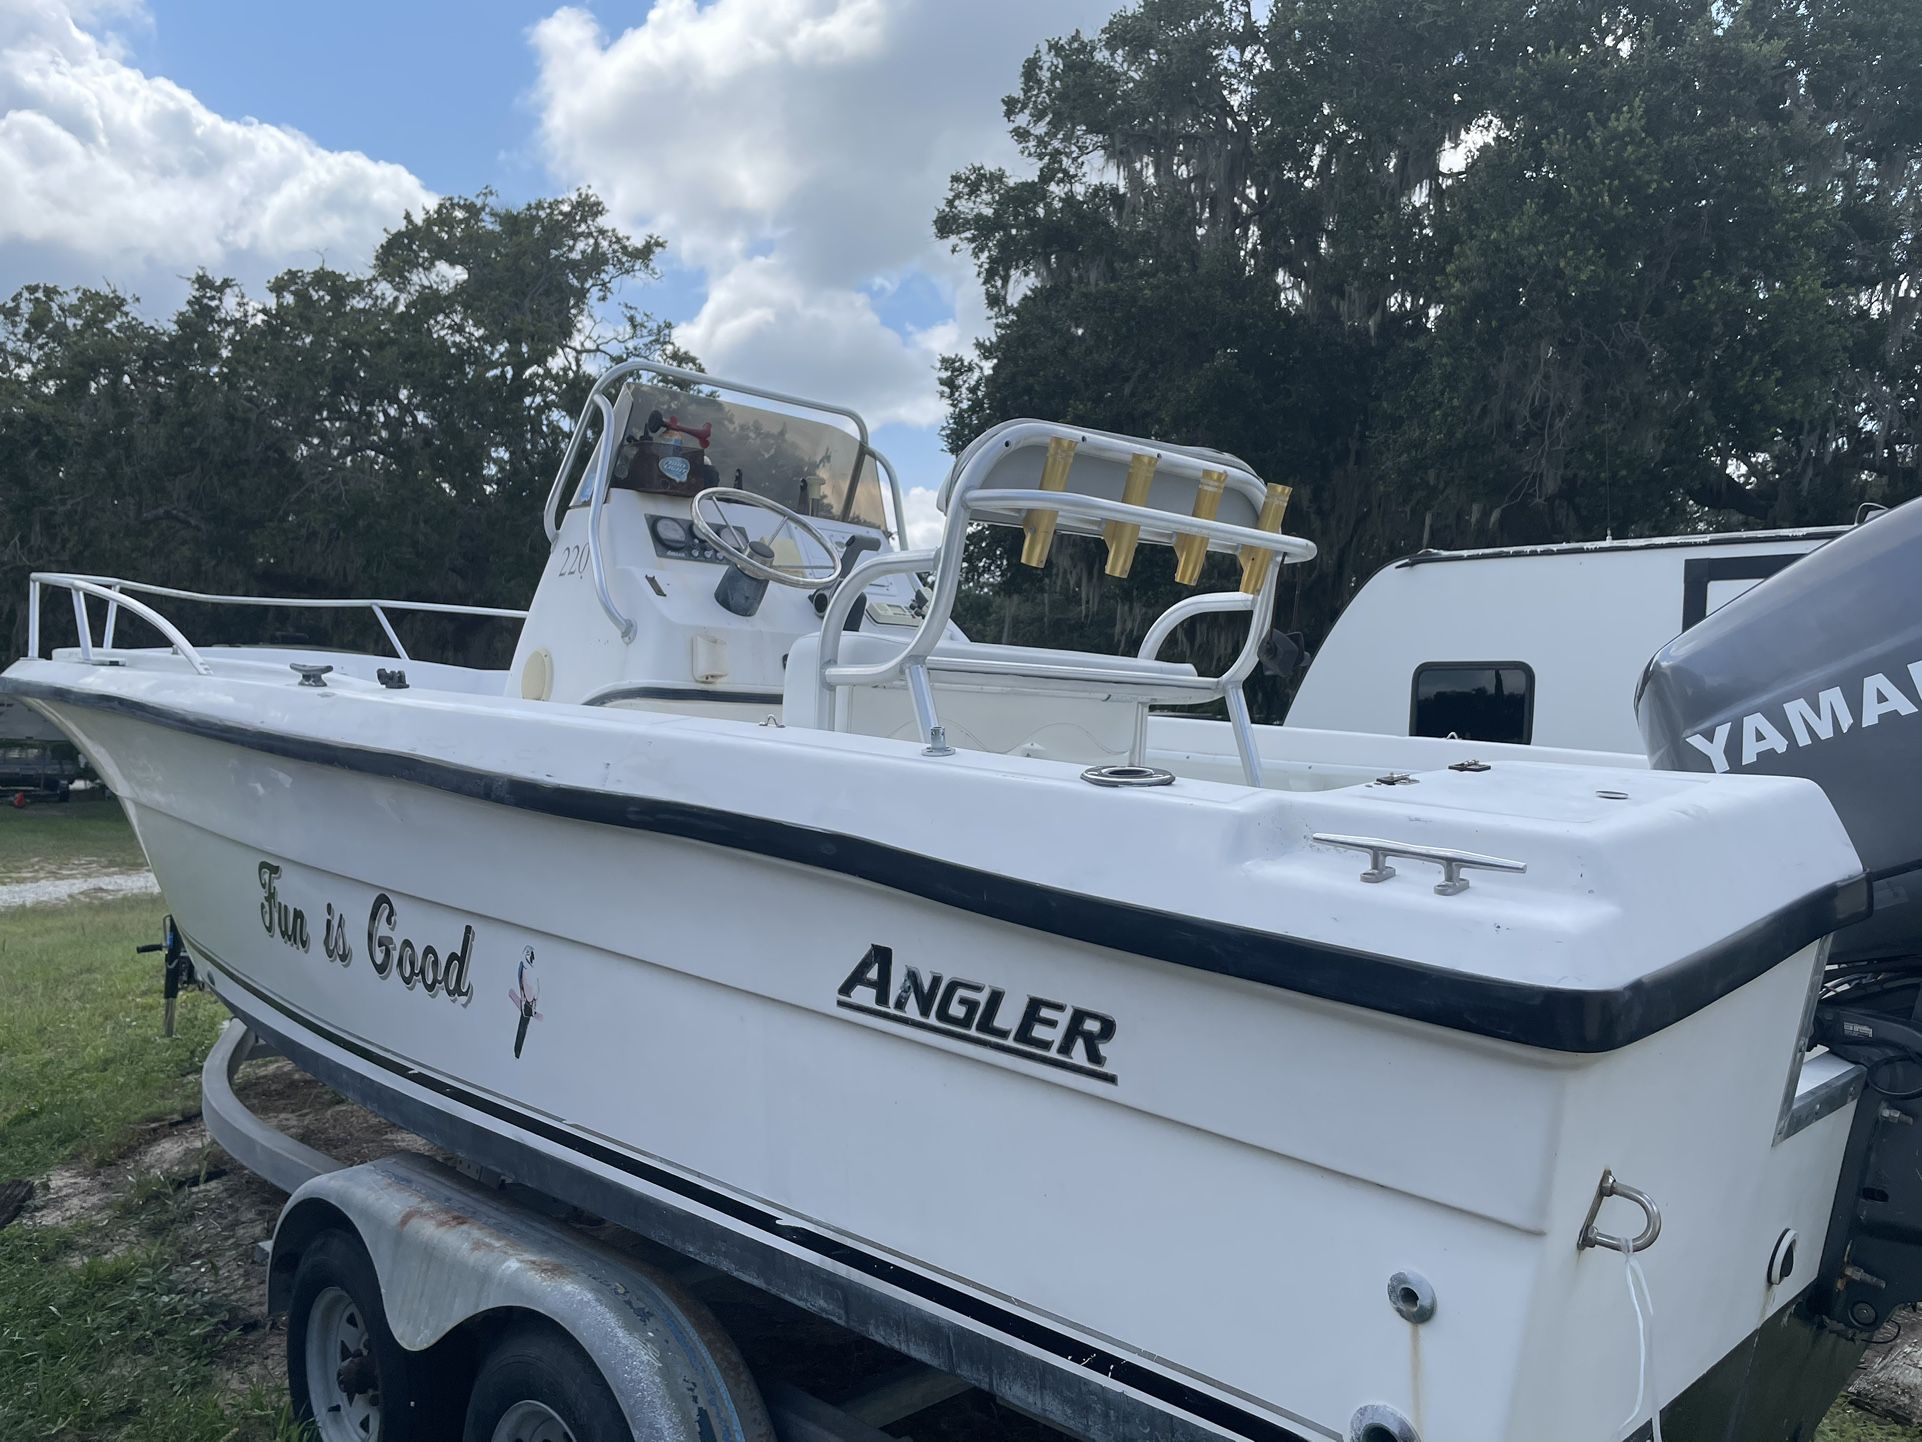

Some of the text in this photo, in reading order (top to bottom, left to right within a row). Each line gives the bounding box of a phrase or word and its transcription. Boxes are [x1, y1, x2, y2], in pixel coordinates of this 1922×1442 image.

[559, 542, 590, 577] 220
[1685, 660, 1922, 774] YAMA
[258, 861, 476, 1008] Fun is Good
[837, 943, 1117, 1067] ANGLER
